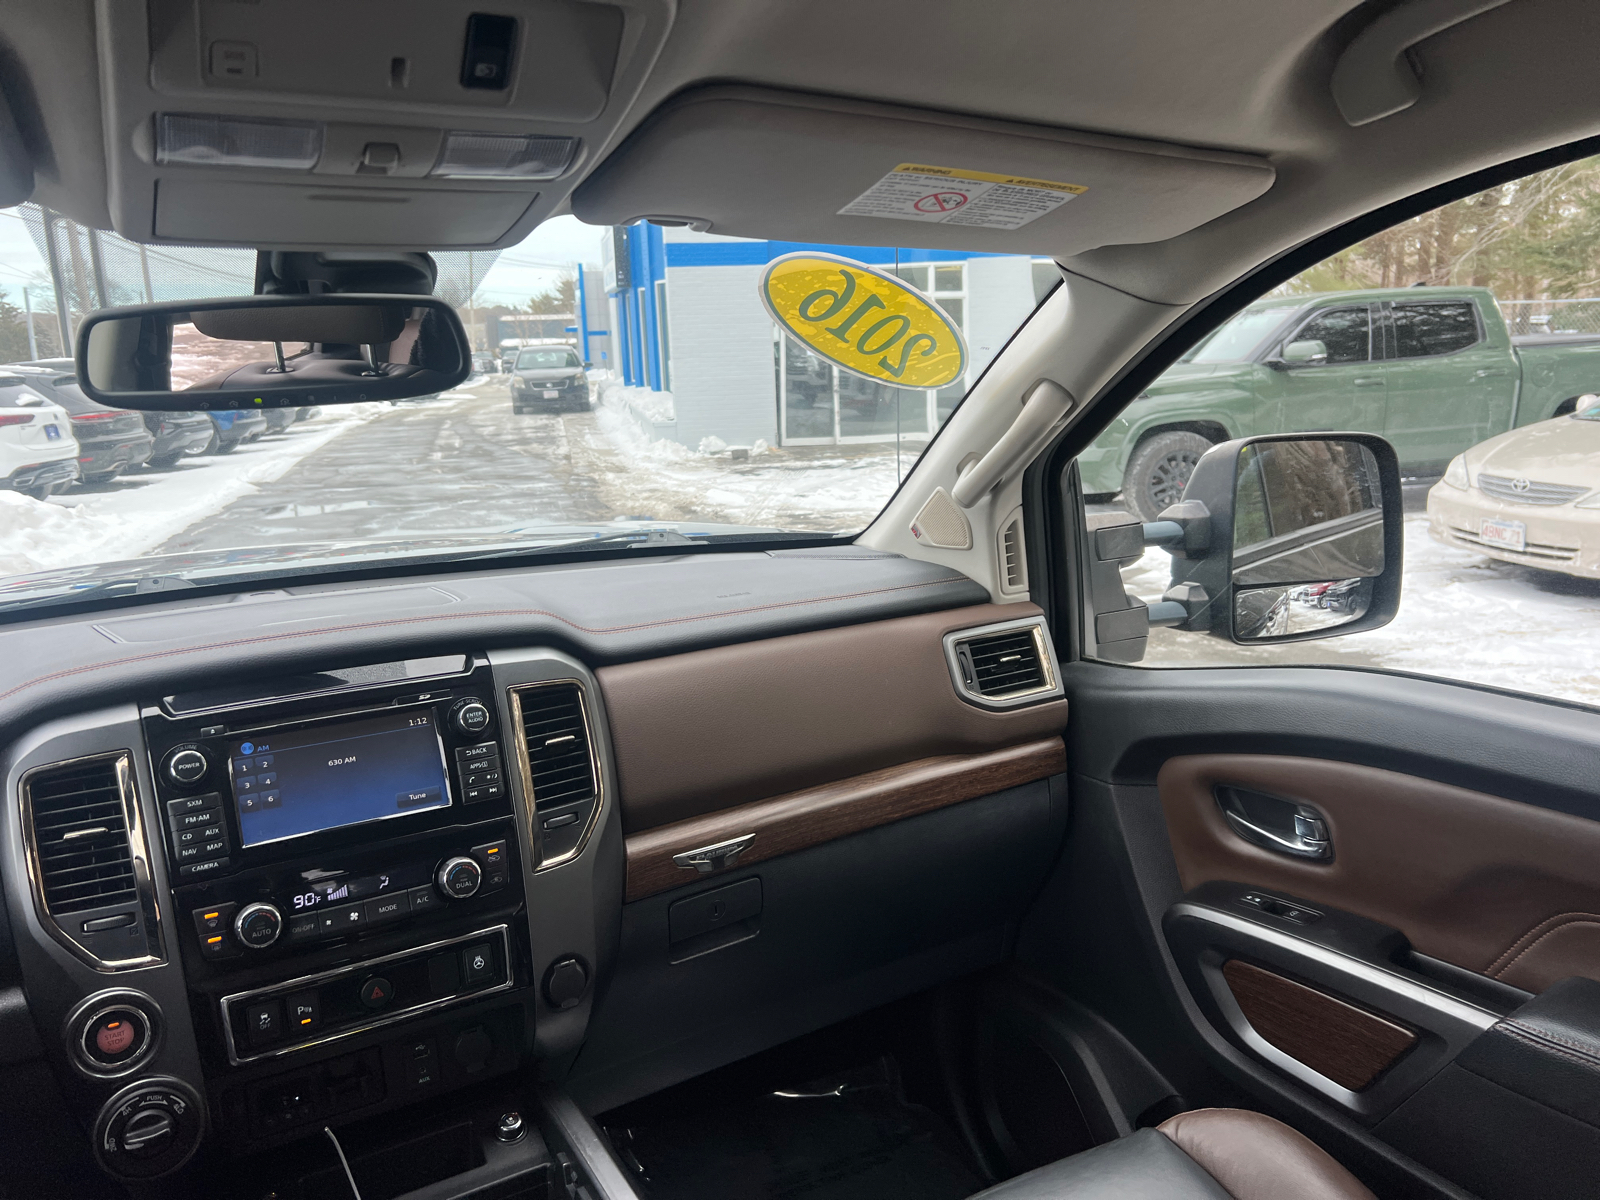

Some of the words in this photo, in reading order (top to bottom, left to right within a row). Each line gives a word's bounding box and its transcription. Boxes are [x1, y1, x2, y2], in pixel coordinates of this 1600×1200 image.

[409, 717, 428, 726] 1:12
[257, 744, 270, 752] AM
[471, 747, 487, 755] BACK
[178, 762, 200, 770] POWER
[328, 758, 343, 767] 630
[344, 756, 357, 764] AM
[409, 792, 427, 801] Tune
[187, 799, 202, 808] SXM
[205, 828, 220, 836] AUX
[182, 848, 197, 856] NAV
[206, 842, 223, 851] MAP
[191, 861, 219, 872] CAMERA
[455, 880, 473, 889] DUAL
[416, 895, 430, 905] A/C
[378, 903, 398, 914] MODE
[252, 928, 272, 938] AUTO
[259, 1022, 271, 1030] OFF
[104, 1029, 126, 1041] START
[107, 1037, 125, 1046] STOP
[418, 1076, 431, 1084] AUX
[122, 1105, 133, 1117] 4H
